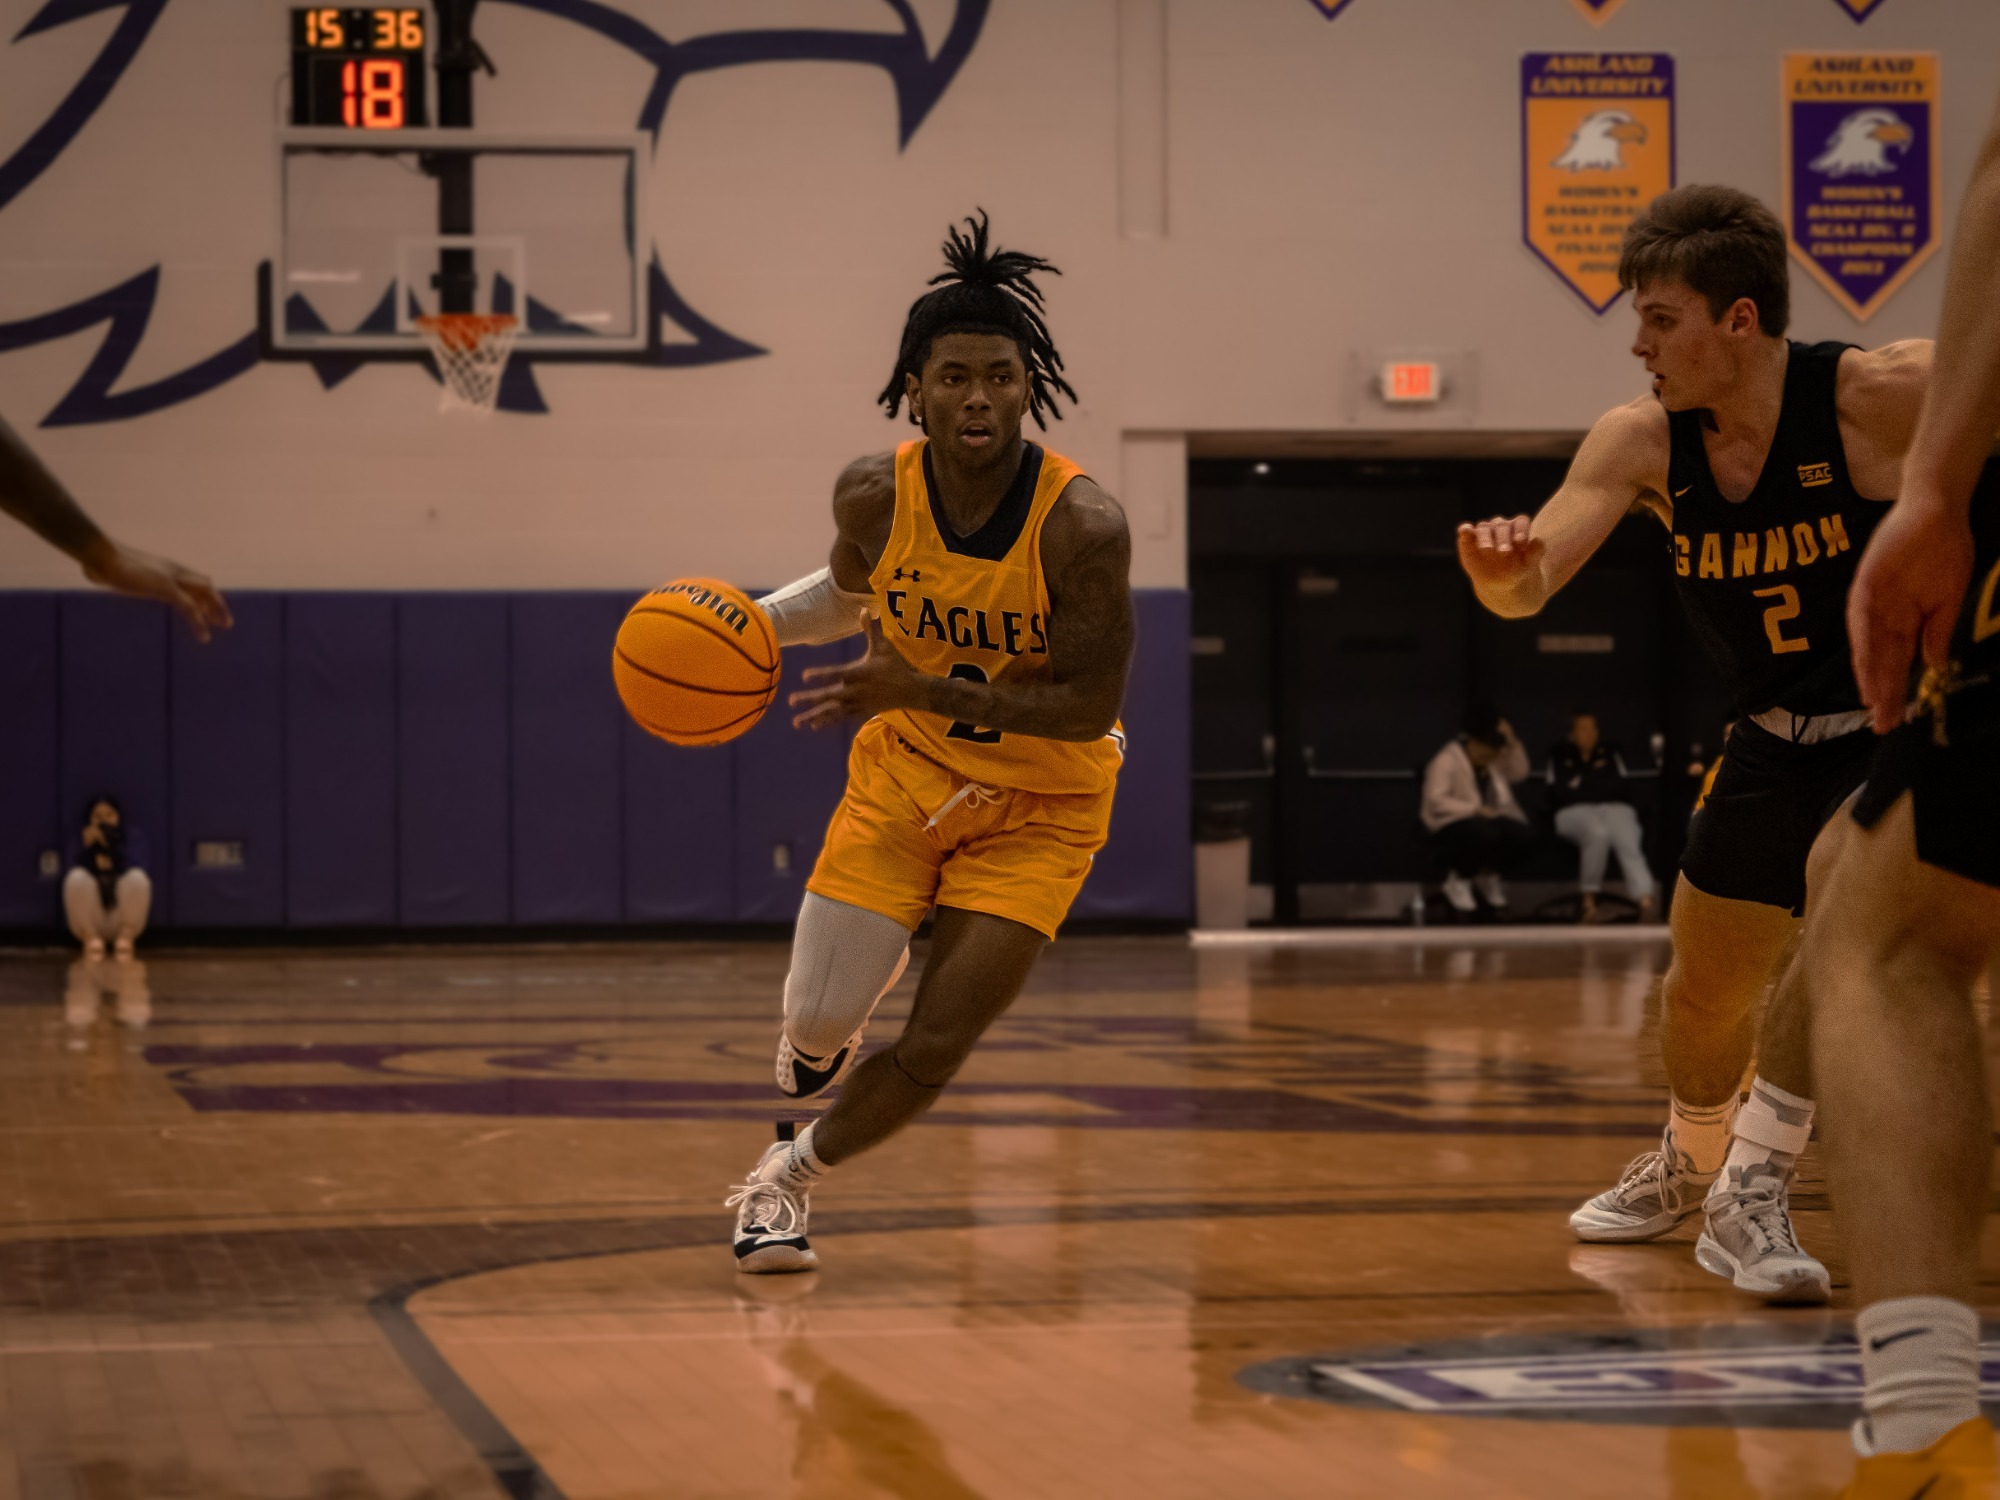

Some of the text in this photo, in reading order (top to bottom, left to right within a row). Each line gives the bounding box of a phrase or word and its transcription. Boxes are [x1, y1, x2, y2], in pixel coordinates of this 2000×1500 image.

[1544, 56, 1654, 73] ASHLAND
[1808, 57, 1915, 73] ASHLAND
[342, 59, 403, 129] 18
[1531, 76, 1668, 94] UNIVERSITY
[1794, 77, 1926, 95] UNIVERSITY
[1806, 204, 1916, 219] BASKETBALL
[1798, 466, 1833, 482] PSAC
[1674, 513, 1850, 579] GANNON
[886, 589, 1048, 656] EAGLES
[1752, 583, 1810, 654] 2
